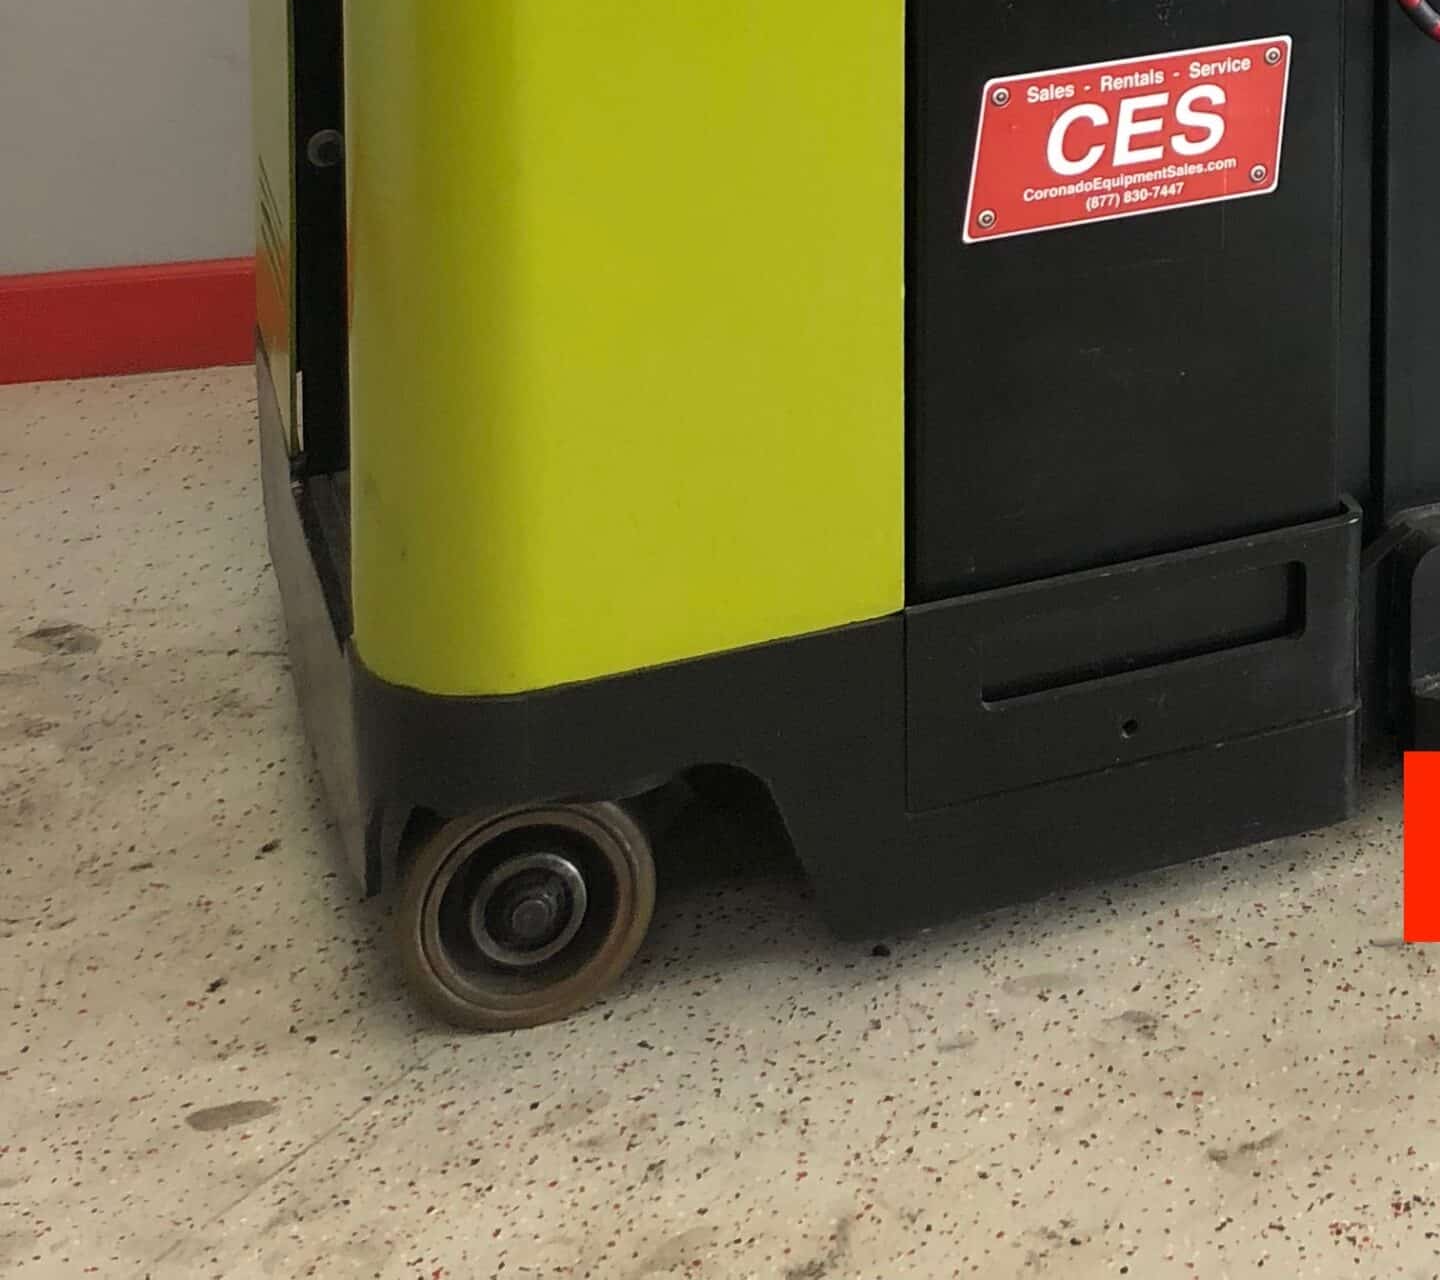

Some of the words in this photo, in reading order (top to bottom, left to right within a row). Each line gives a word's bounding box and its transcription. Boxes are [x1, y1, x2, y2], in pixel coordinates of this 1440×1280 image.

[1027, 83, 1075, 104] Sales
[1100, 68, 1165, 92] Rentals
[1189, 57, 1251, 79] Service
[1046, 84, 1227, 176] CES
[1023, 157, 1237, 203] CoronadoEquipmentSales.com
[1085, 192, 1121, 212] (877)
[1123, 182, 1185, 204] 830-7447
